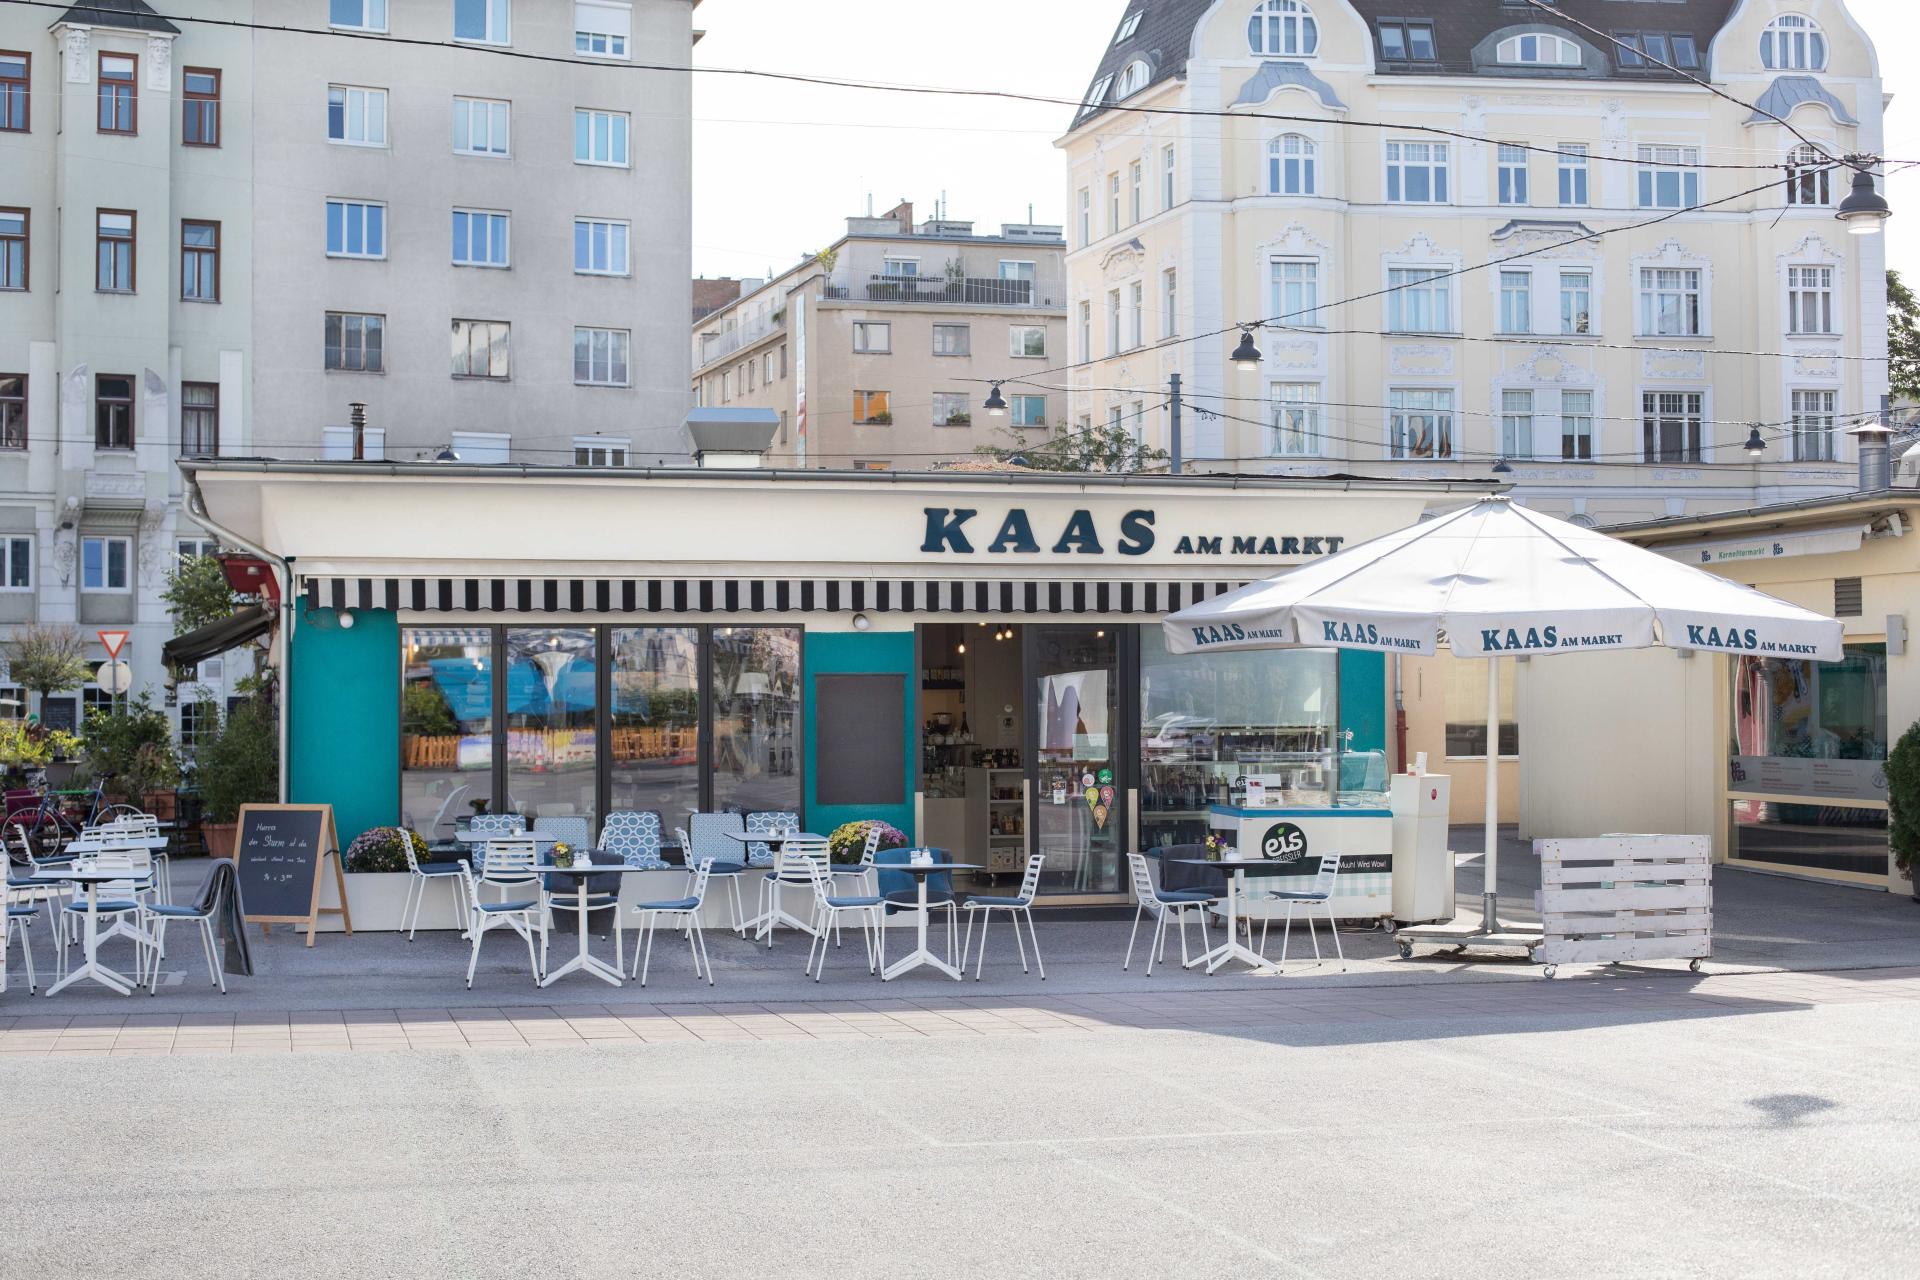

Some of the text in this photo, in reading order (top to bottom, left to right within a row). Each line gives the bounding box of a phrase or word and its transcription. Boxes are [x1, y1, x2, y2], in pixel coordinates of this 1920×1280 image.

[920, 507, 1344, 555] KAAS AM MARKT
[1192, 623, 1283, 645] KAAS AM MARKT
[1323, 621, 1421, 649] KAAS AM MARKT
[1481, 626, 1623, 651] KAAS AM MARKT
[1687, 624, 1817, 654] KAAS AM MARKT
[263, 835, 285, 847] Sturm
[1265, 831, 1303, 857] eis
